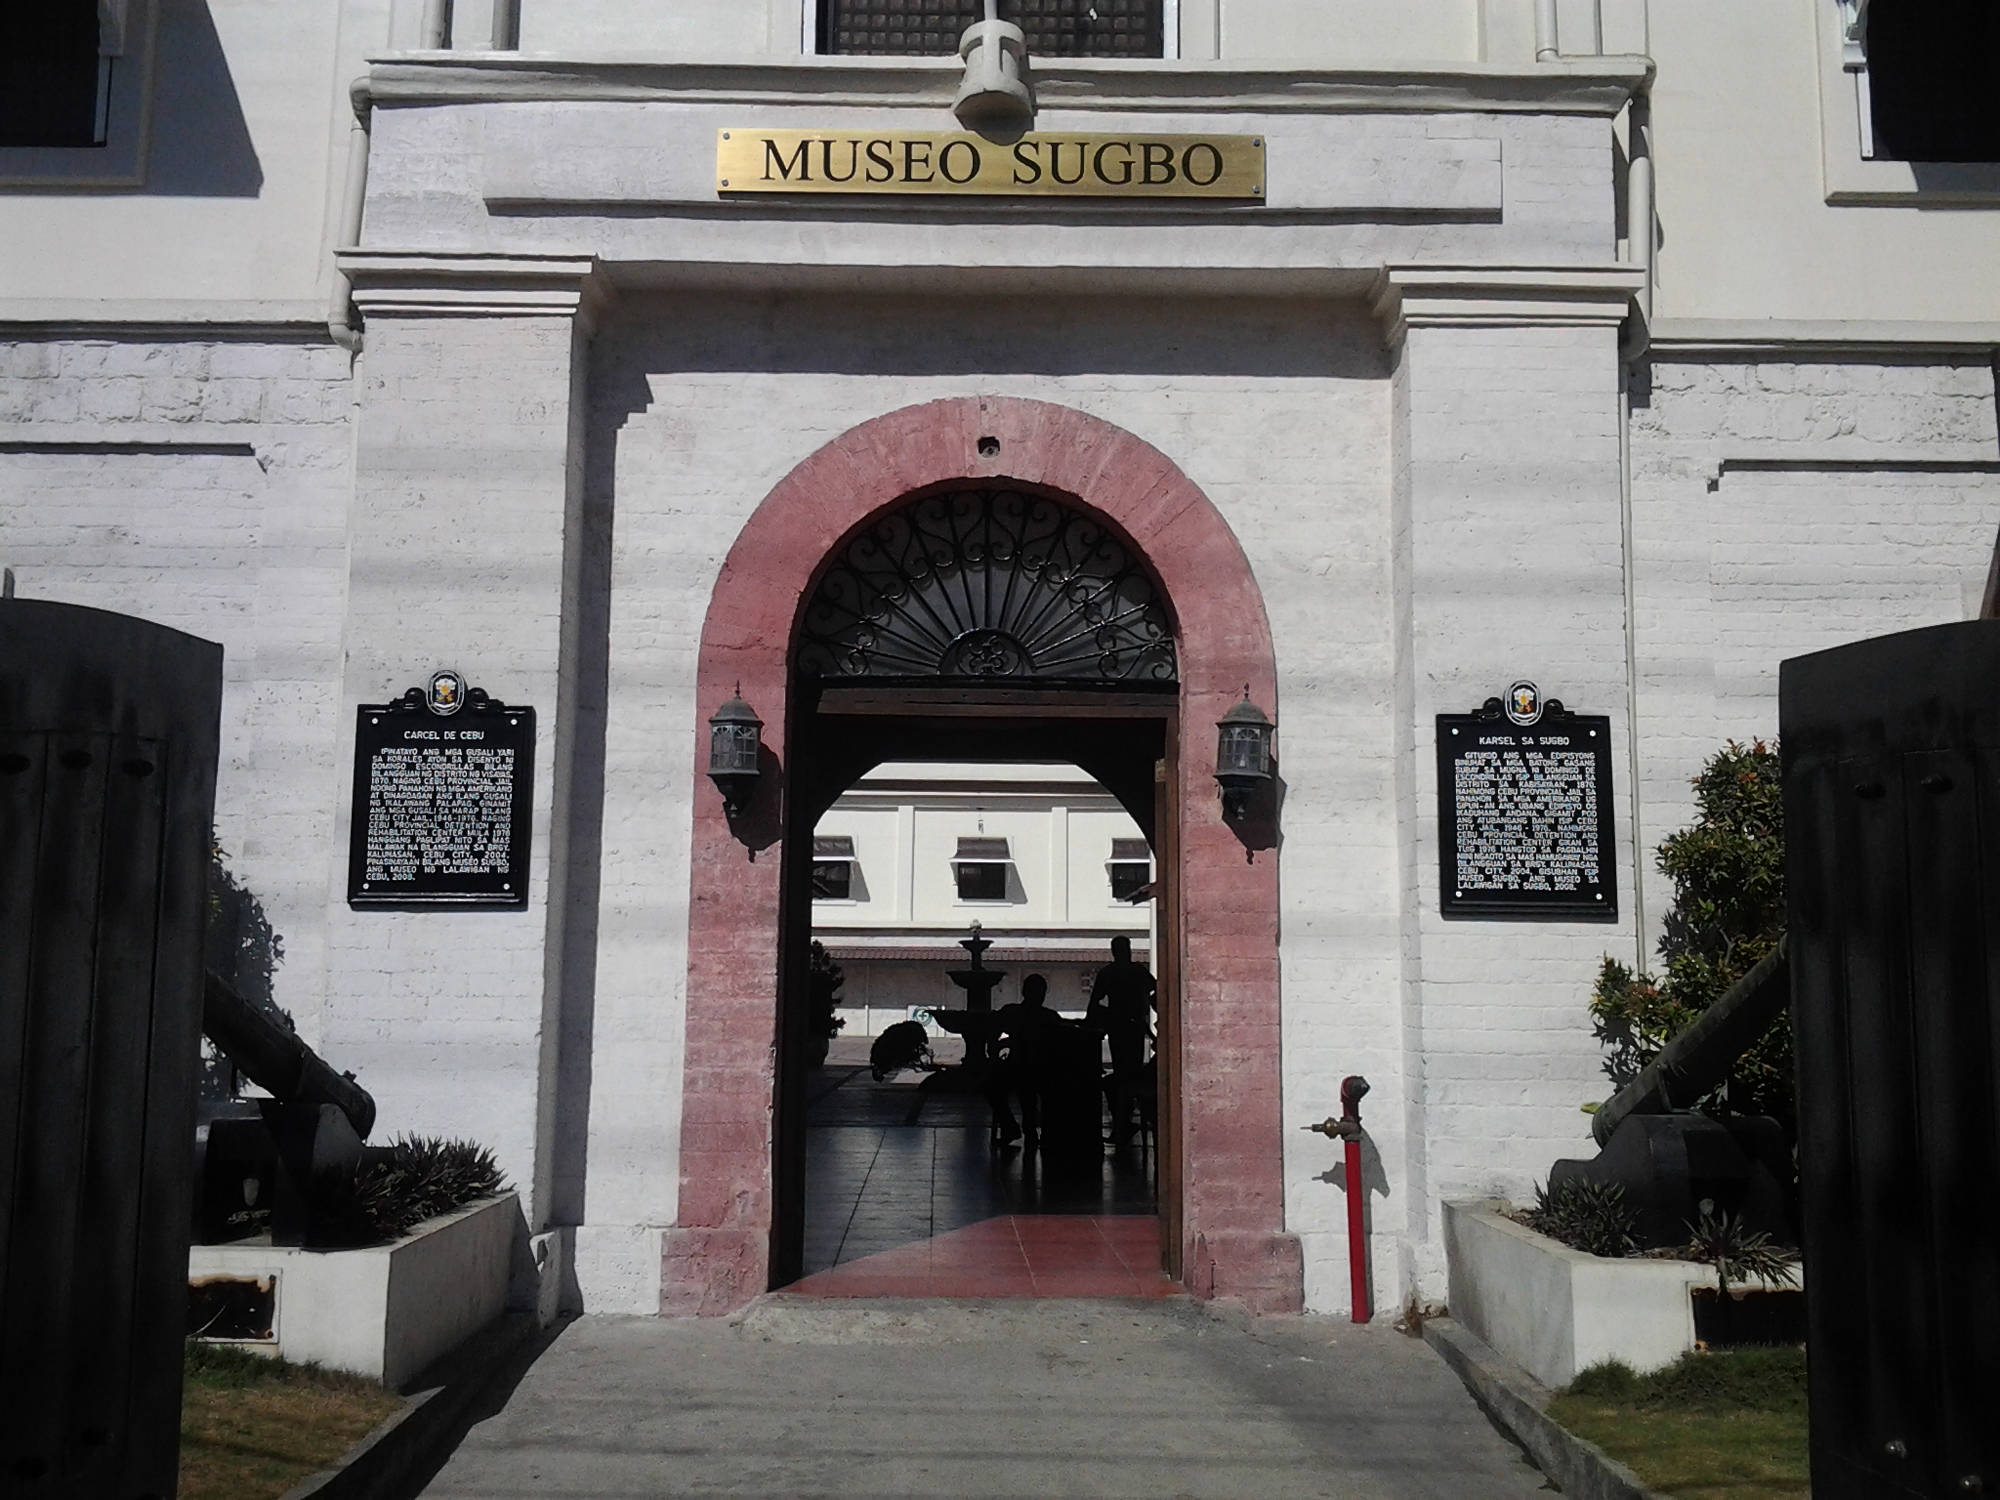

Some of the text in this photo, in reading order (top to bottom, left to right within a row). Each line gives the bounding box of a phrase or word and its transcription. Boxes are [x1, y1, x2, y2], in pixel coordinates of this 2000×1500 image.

[760, 138, 1224, 187] MUSEO SUGBO
[403, 730, 484, 740] CARCEL DE CEBU
[1478, 736, 1570, 746] KARSEL SA SUGBO
